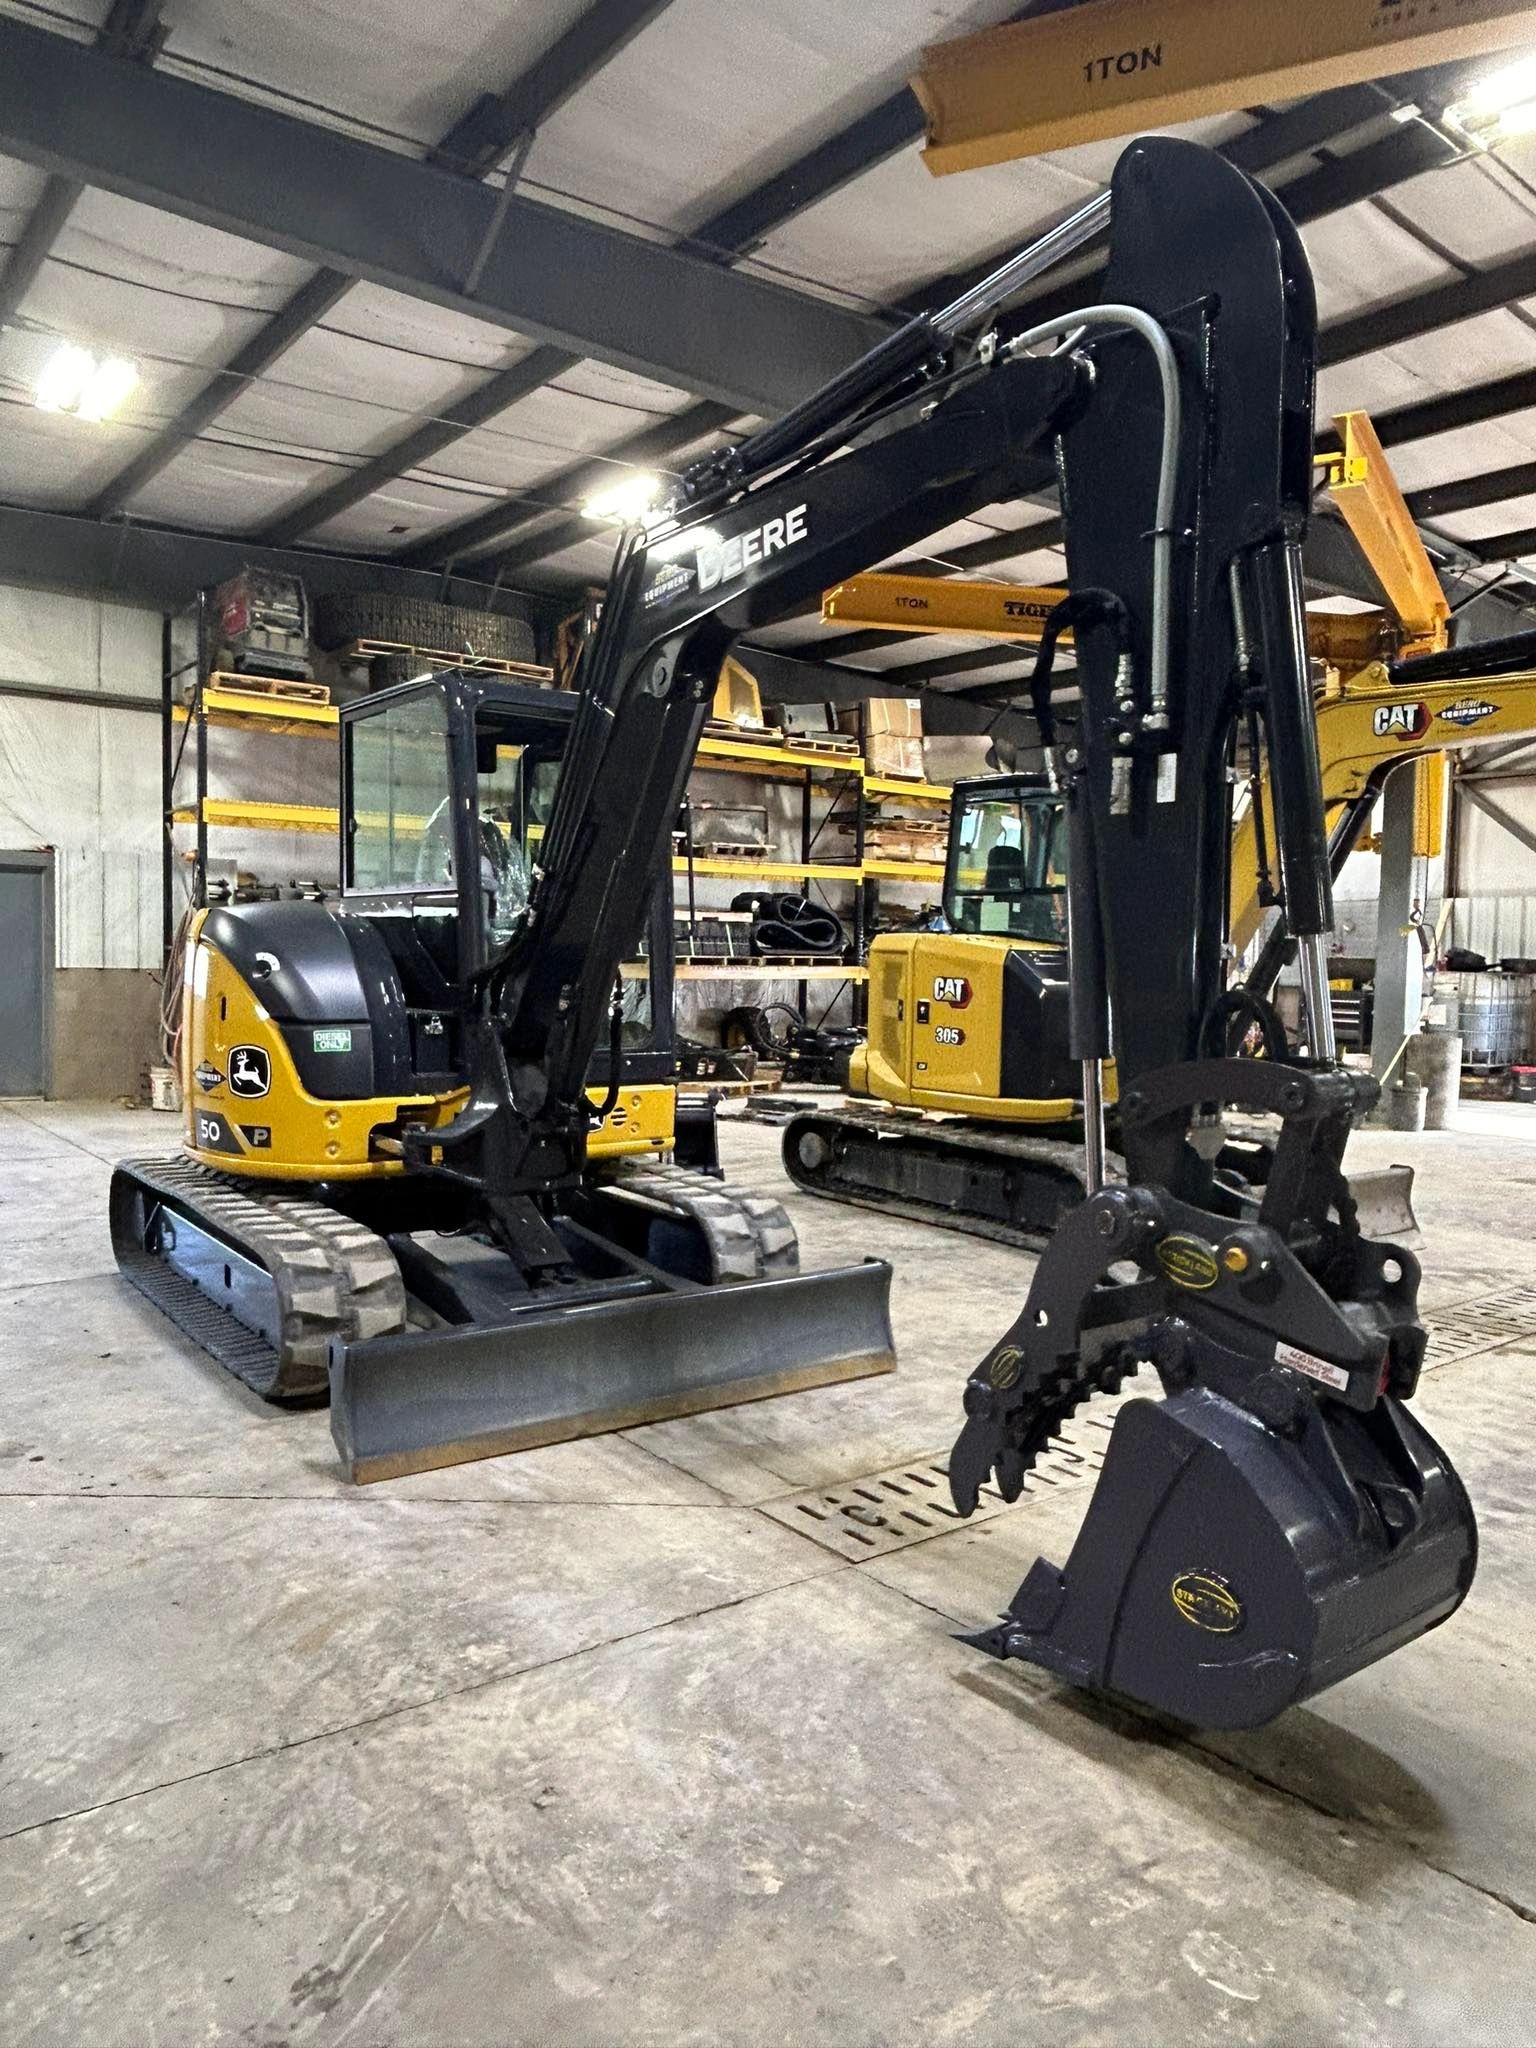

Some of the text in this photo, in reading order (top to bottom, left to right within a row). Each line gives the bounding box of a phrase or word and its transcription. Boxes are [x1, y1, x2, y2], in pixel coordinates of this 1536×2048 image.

[697, 503, 807, 593] DEERE
[1374, 703, 1419, 736] CAT
[934, 977, 965, 1001] CAT
[320, 1039, 346, 1049] ONLY
[935, 1026, 960, 1044] 305
[201, 1118, 220, 1141] 50
[253, 1128, 268, 1145] P
